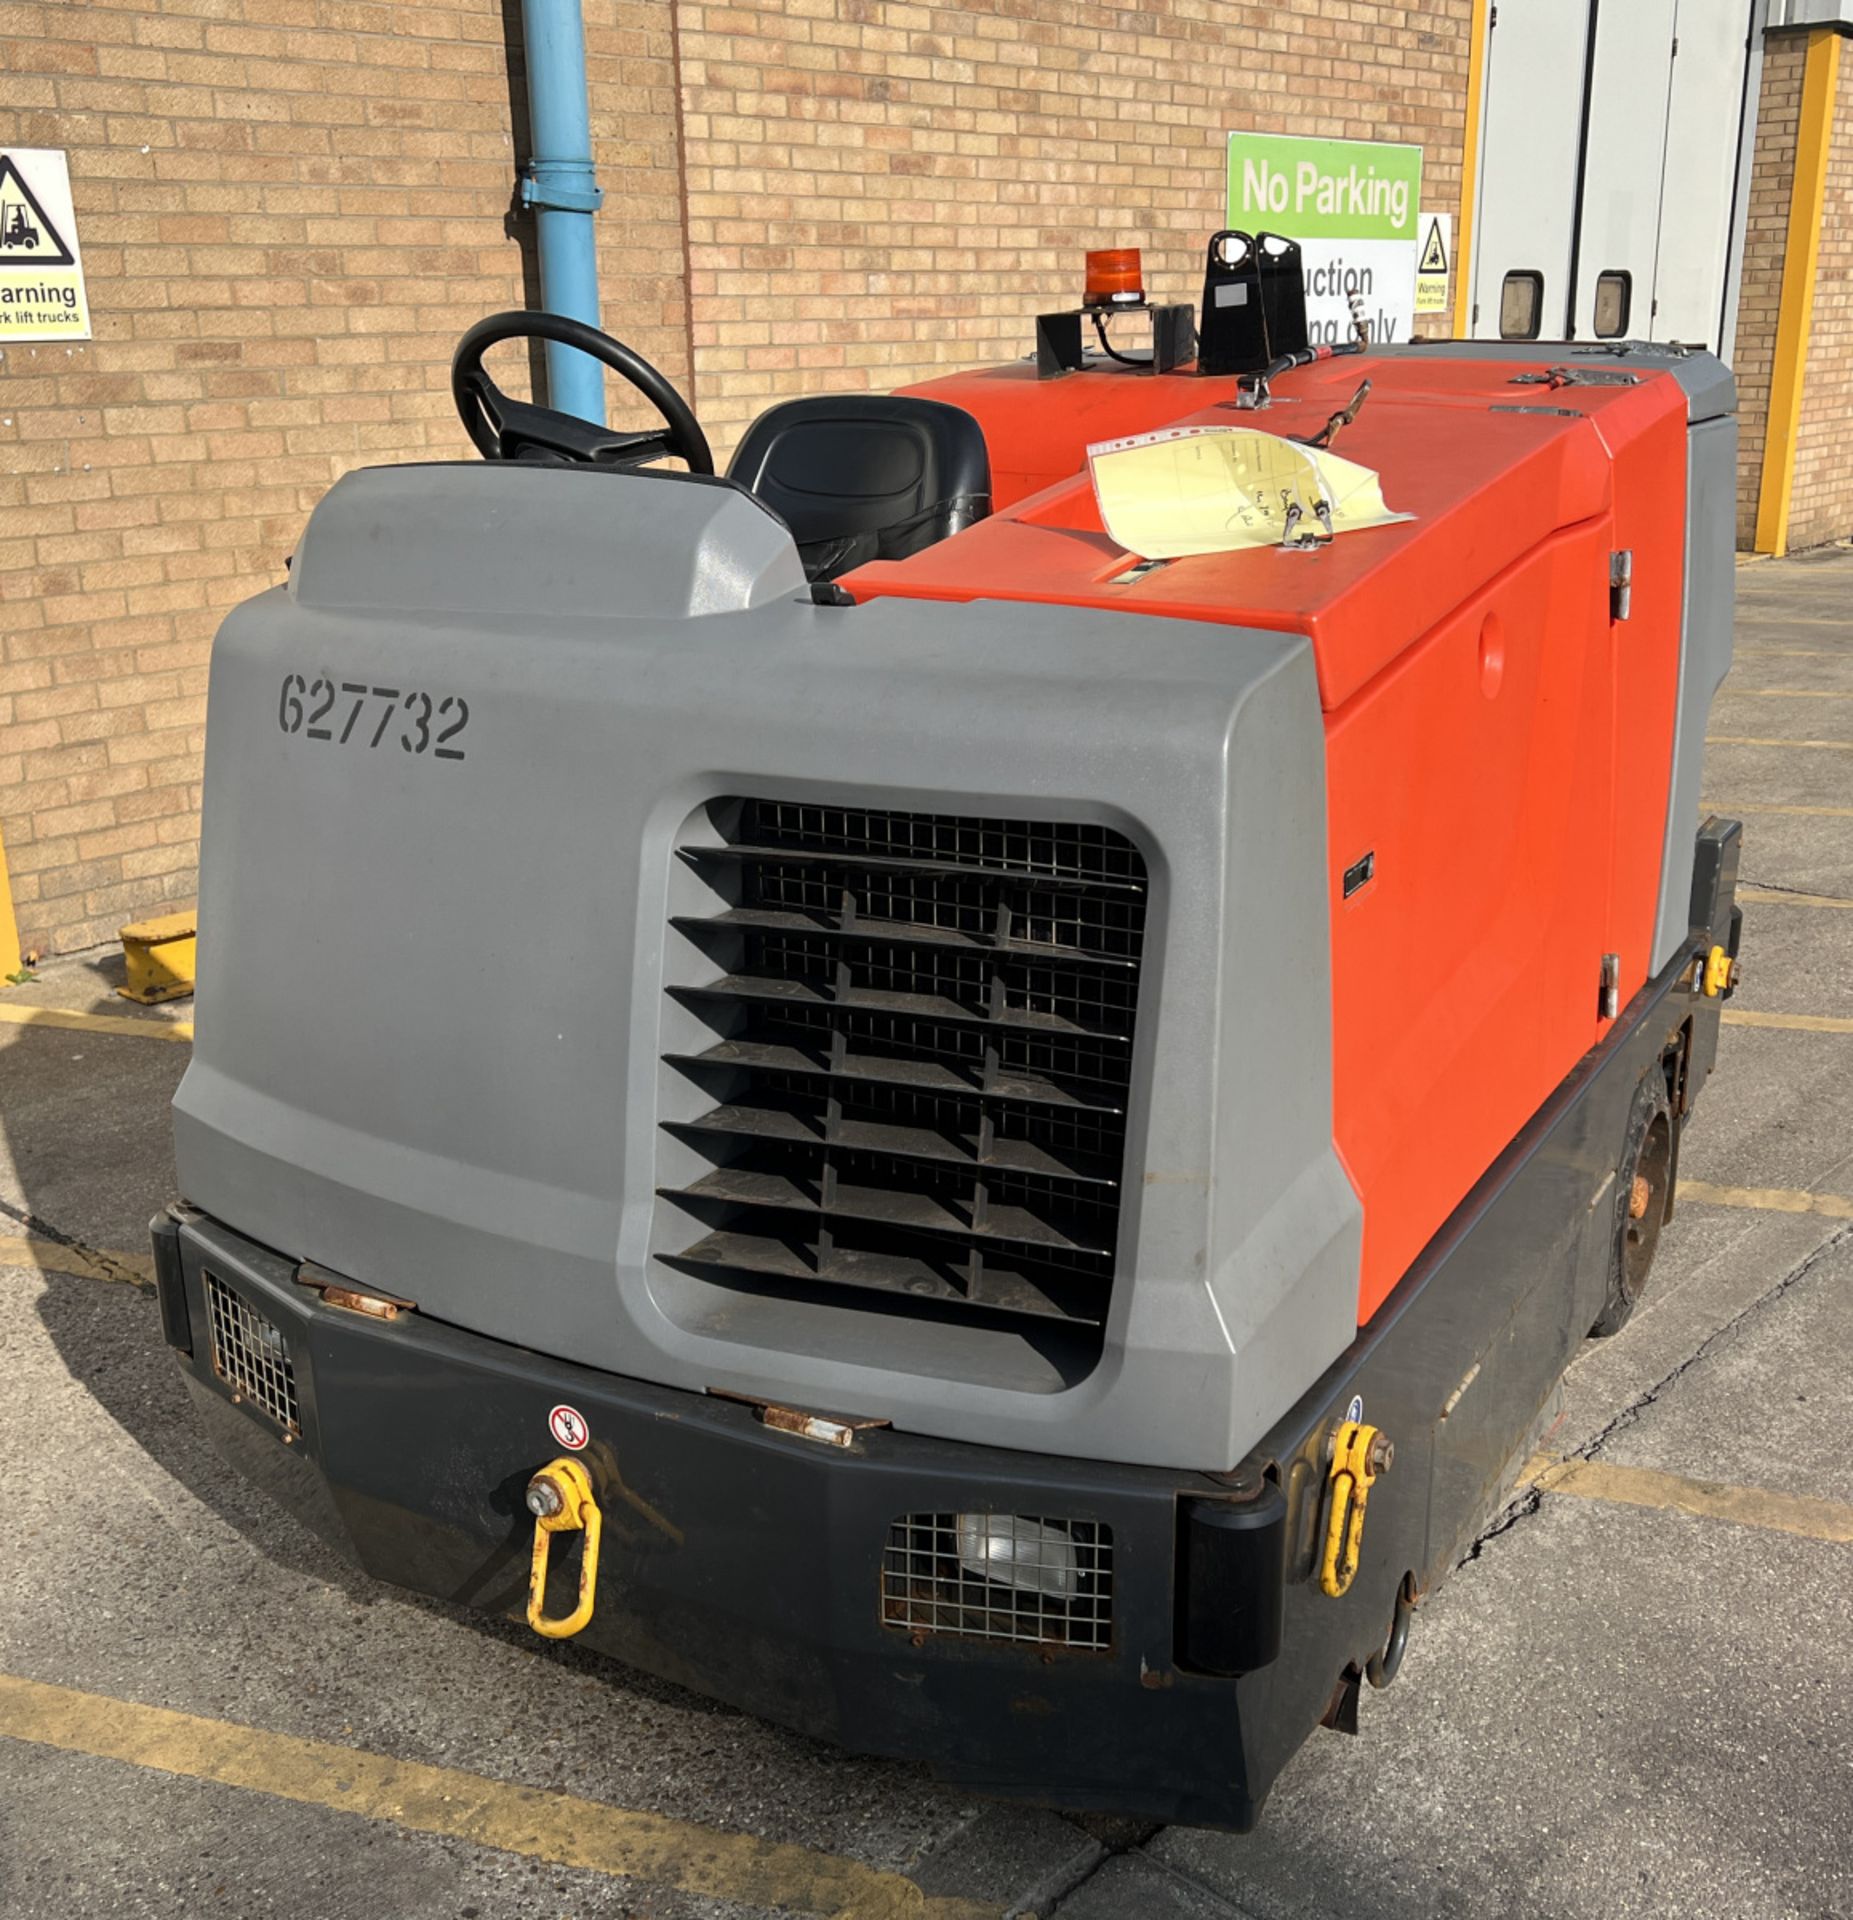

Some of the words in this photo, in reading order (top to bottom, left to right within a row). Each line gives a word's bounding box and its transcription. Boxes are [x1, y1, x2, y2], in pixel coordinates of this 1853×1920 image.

[1243, 158, 1289, 213] No
[1295, 161, 1409, 229] Parking
[15, 311, 34, 324] lift
[37, 310, 80, 323] trucks
[279, 674, 469, 760] 627732
